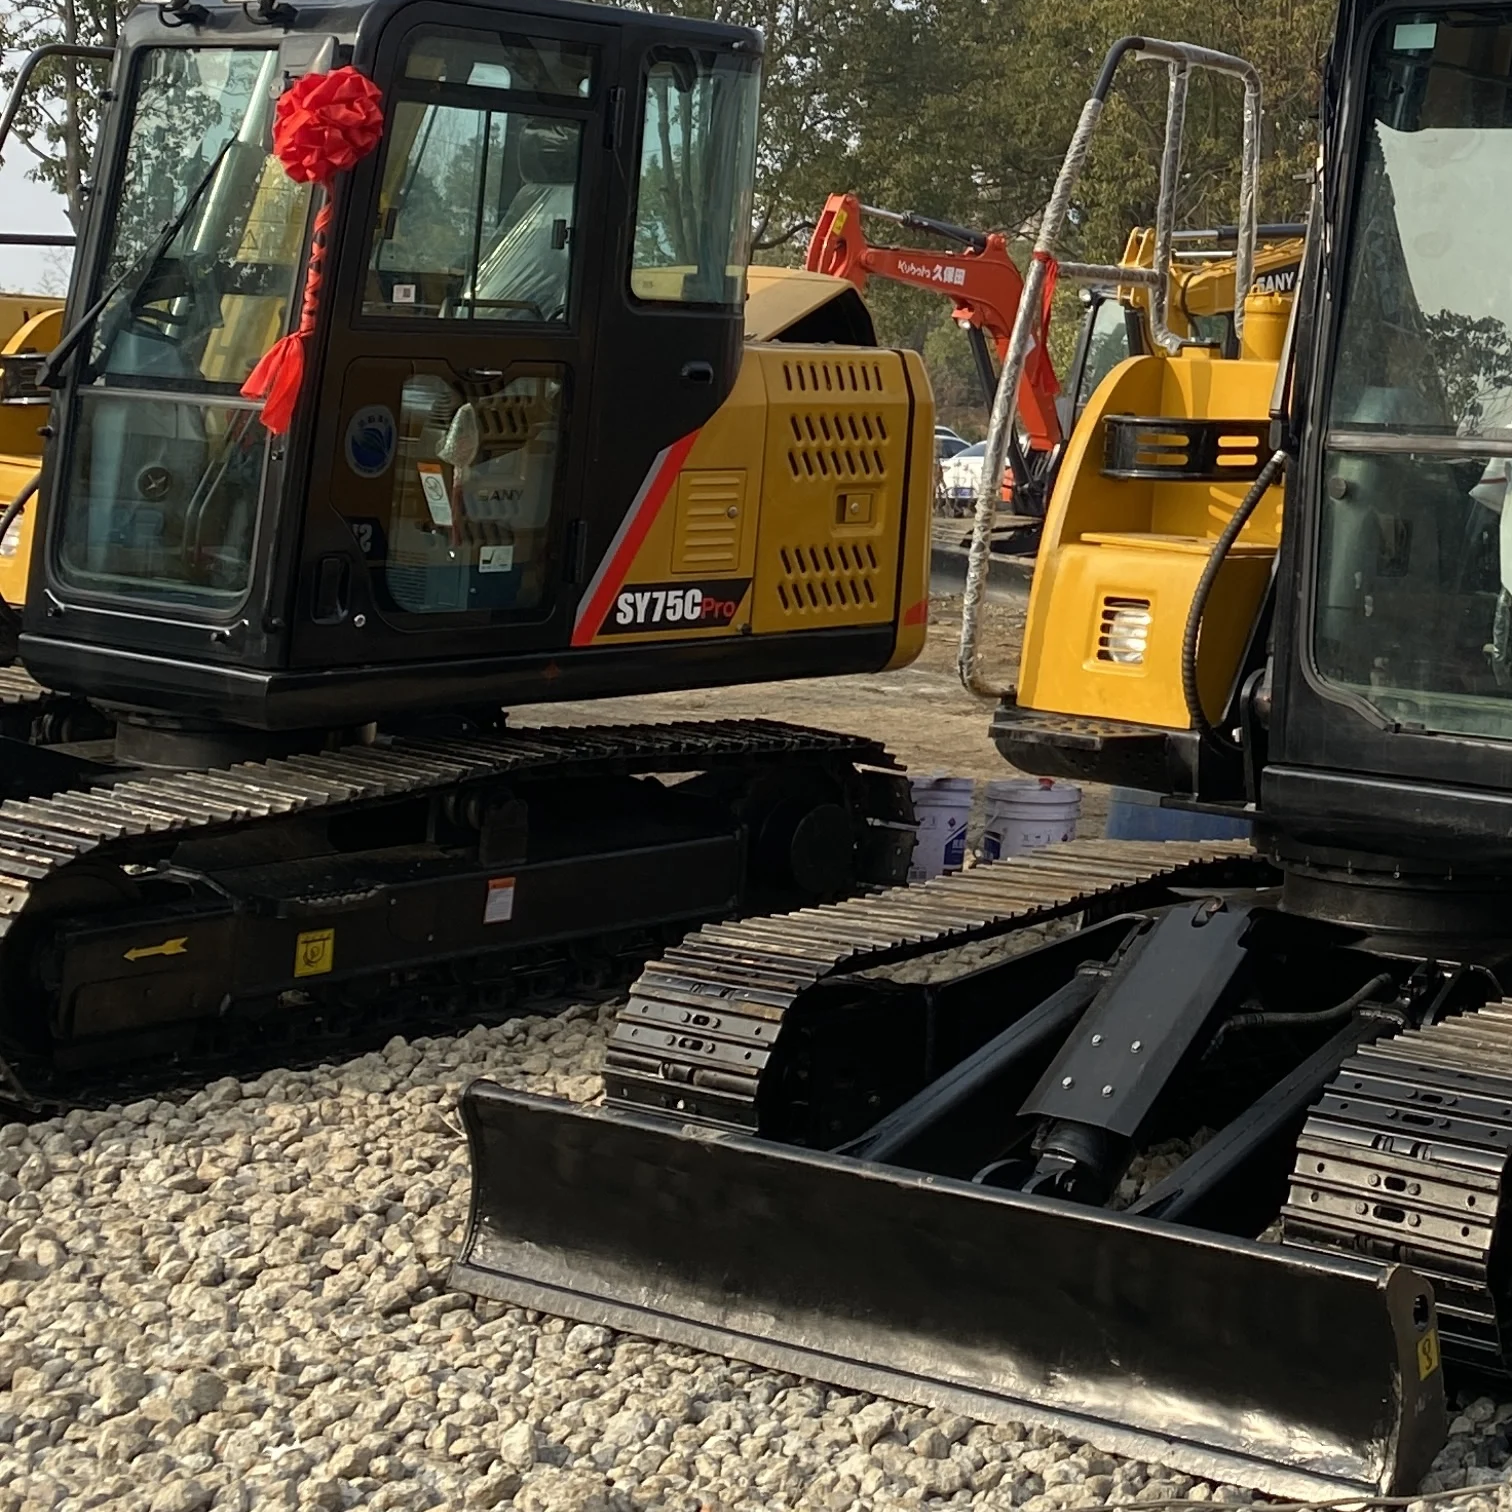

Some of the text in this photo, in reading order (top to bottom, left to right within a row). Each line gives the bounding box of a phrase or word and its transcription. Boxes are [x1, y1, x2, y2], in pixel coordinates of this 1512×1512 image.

[898, 260, 966, 286] Kubota 久保田
[1256, 271, 1295, 292] SANY
